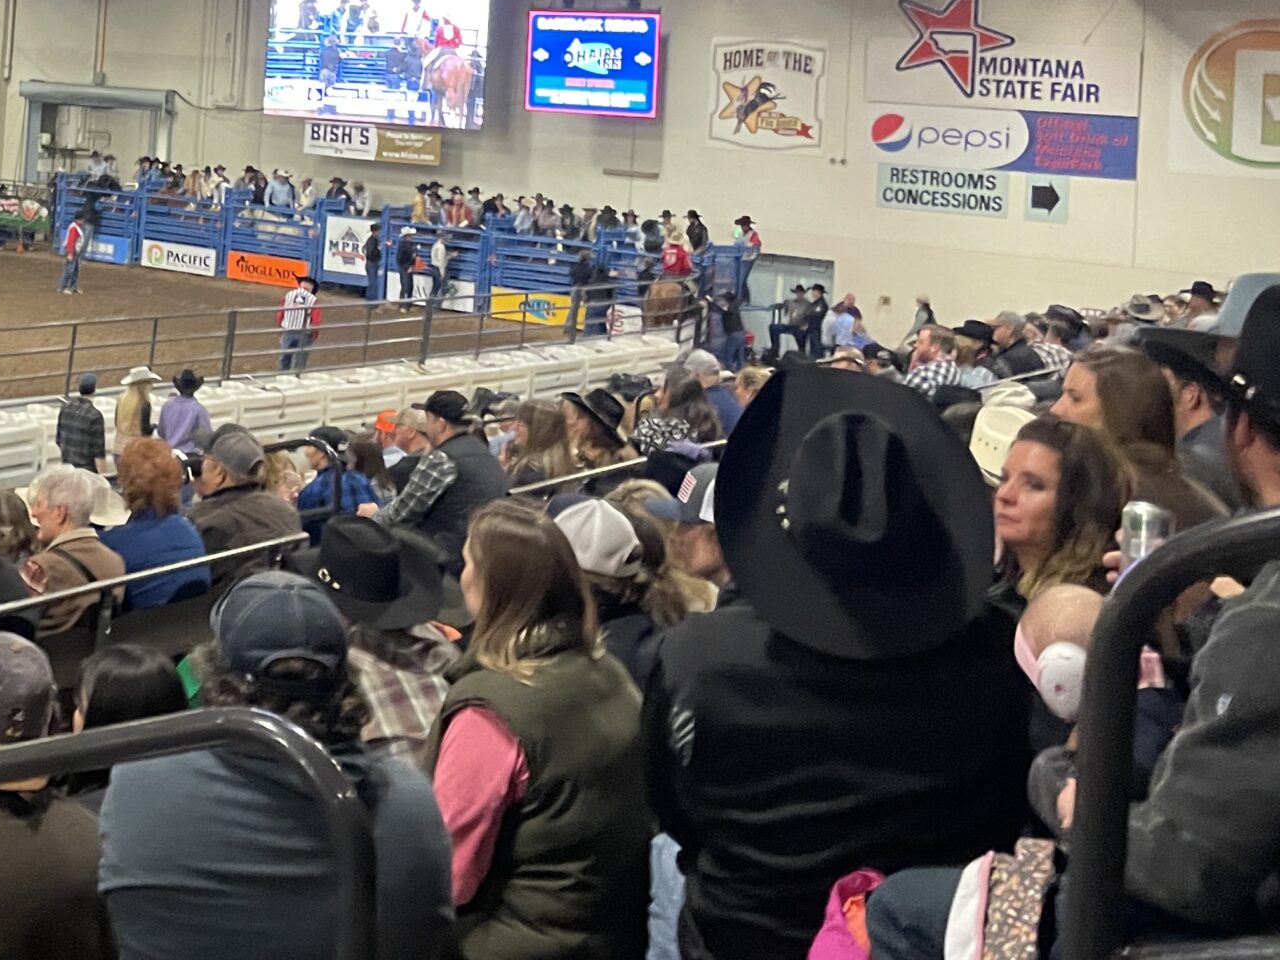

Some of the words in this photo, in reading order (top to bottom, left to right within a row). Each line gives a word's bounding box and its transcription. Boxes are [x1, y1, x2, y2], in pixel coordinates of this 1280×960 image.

[723, 48, 765, 71] HOME
[782, 50, 814, 75] THE
[978, 56, 1086, 80] MONTANA
[978, 78, 1043, 101] STATE
[1050, 82, 1101, 104] FAIR
[917, 126, 1011, 153] pepsi
[889, 167, 997, 191] RESTROOMS
[882, 187, 1004, 213] CONCESSIONS
[166, 250, 211, 267] PACIFIC
